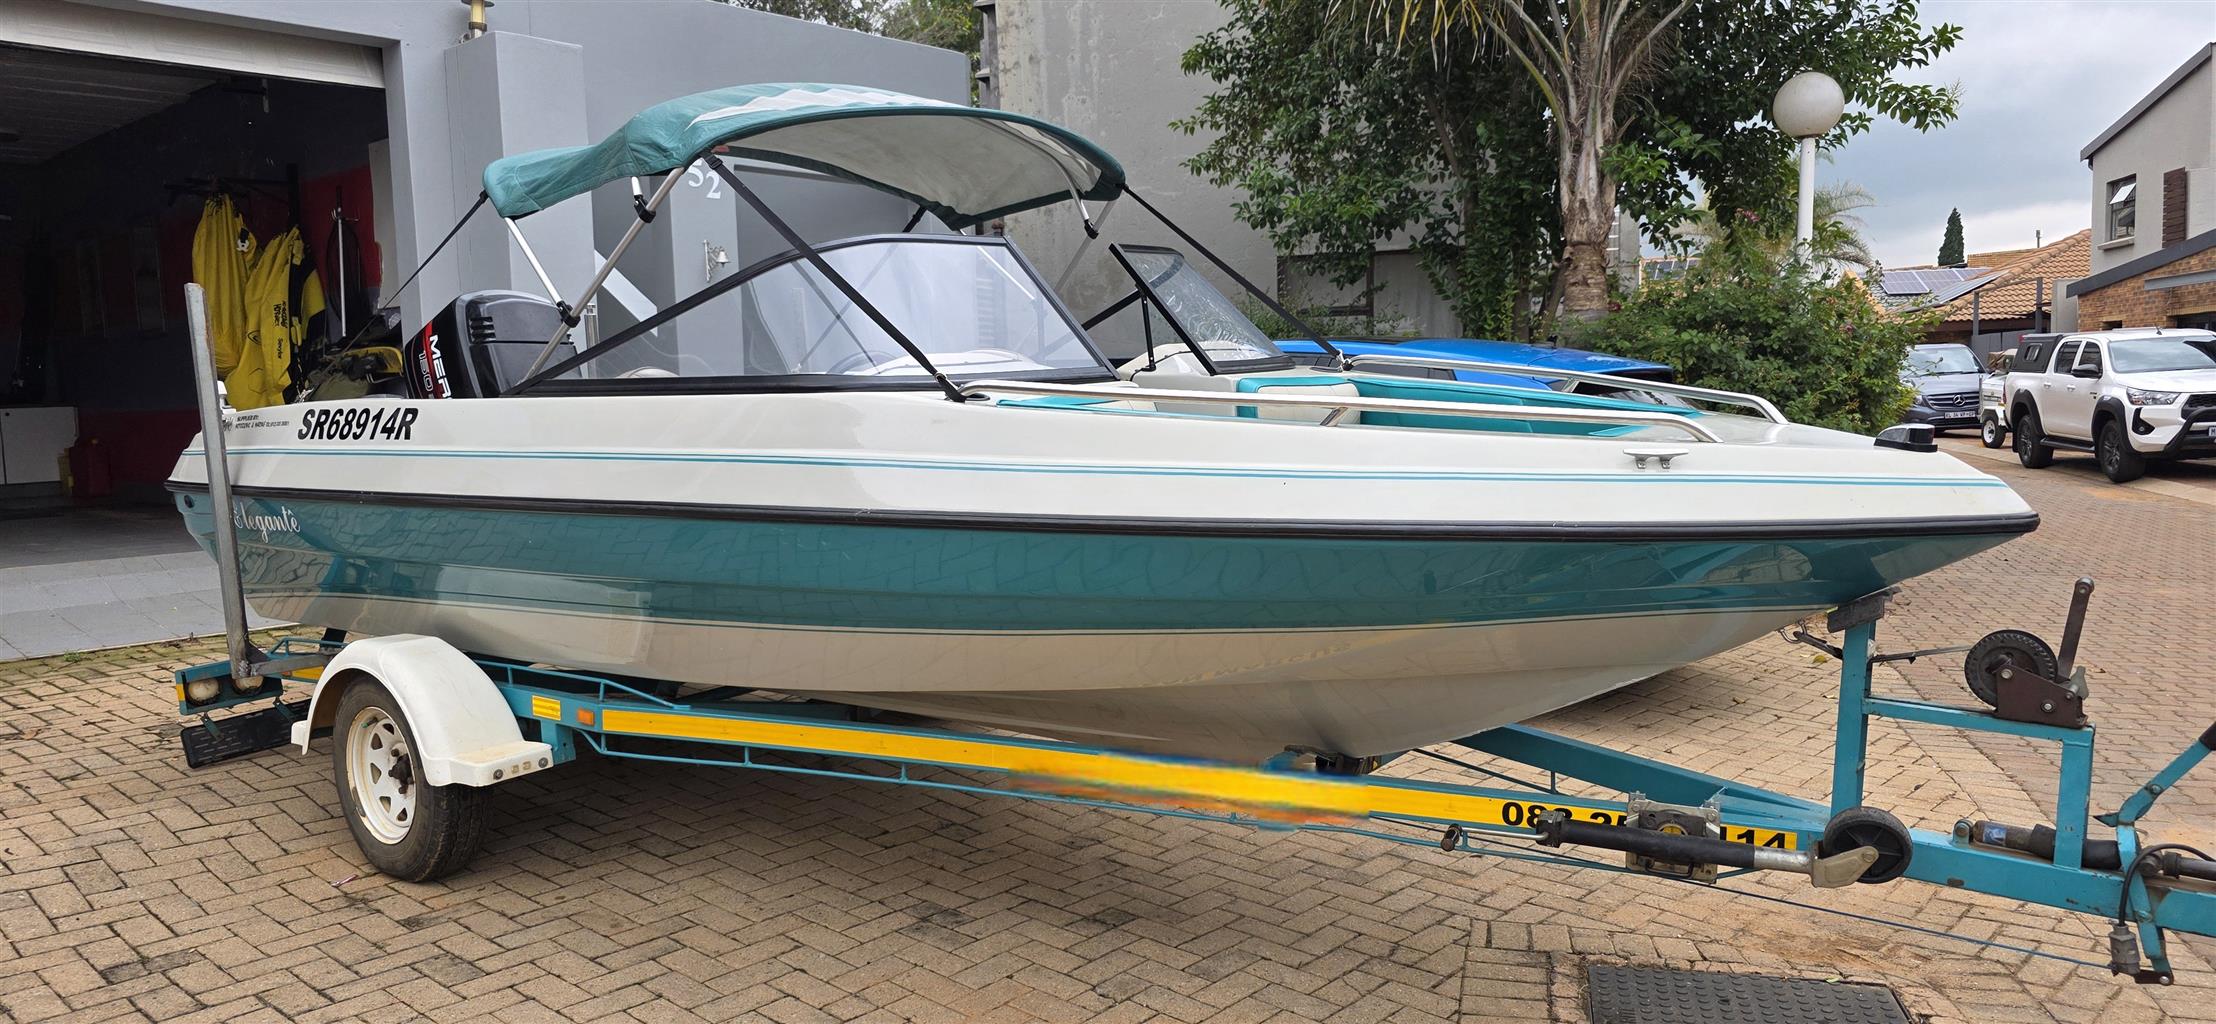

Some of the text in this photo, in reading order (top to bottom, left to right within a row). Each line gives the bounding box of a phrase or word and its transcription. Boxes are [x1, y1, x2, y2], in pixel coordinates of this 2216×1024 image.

[418, 350, 434, 392] 150
[429, 334, 452, 398] MER
[297, 407, 419, 440] SR68914R
